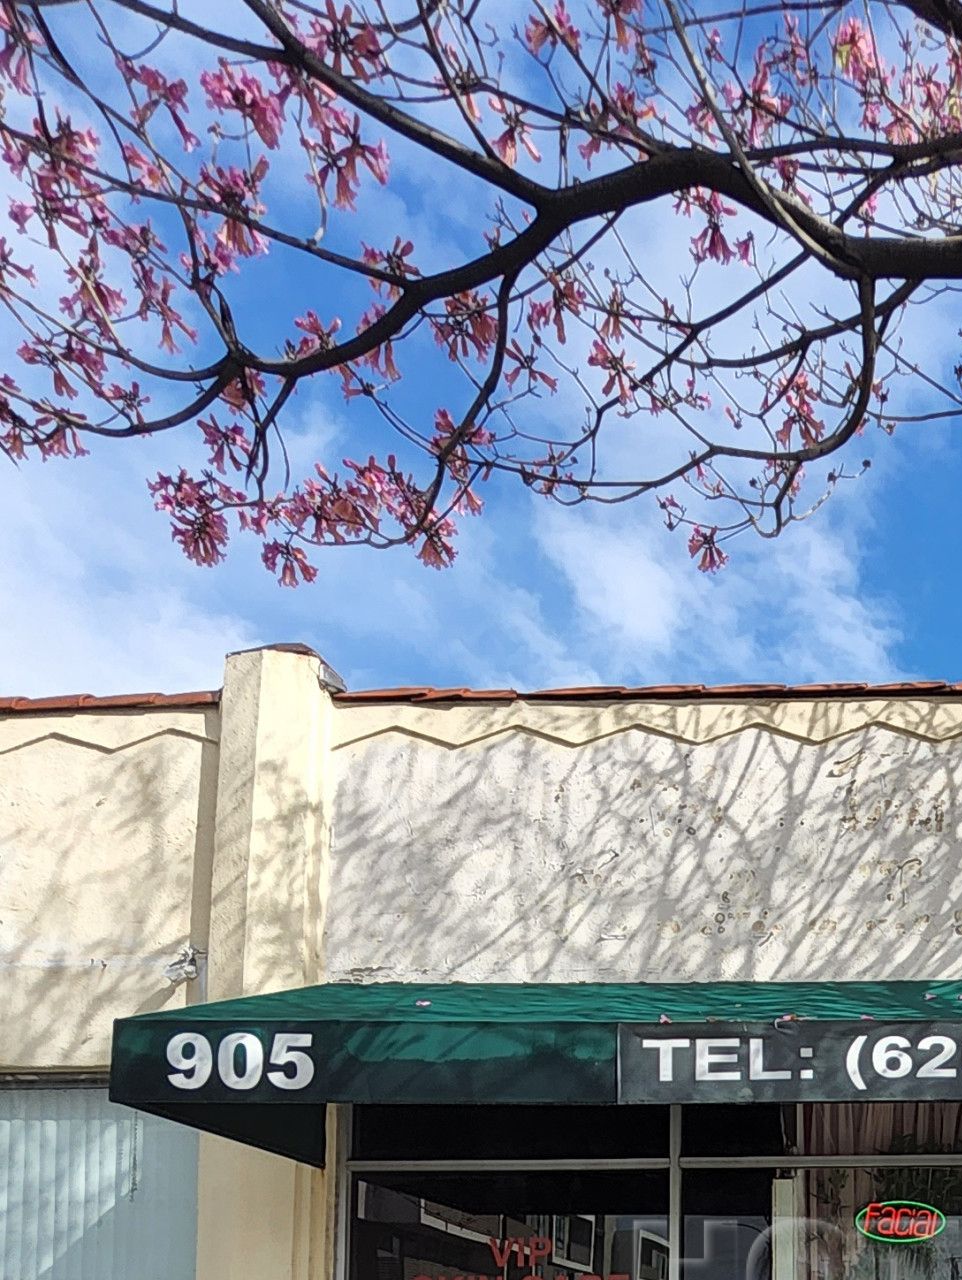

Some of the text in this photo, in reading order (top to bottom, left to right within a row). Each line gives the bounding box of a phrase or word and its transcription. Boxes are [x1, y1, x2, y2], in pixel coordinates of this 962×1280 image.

[166, 1032, 314, 1090] 905
[642, 1037, 814, 1082] TEL:
[864, 1203, 938, 1237] Facial
[489, 1236, 552, 1267] VIP
